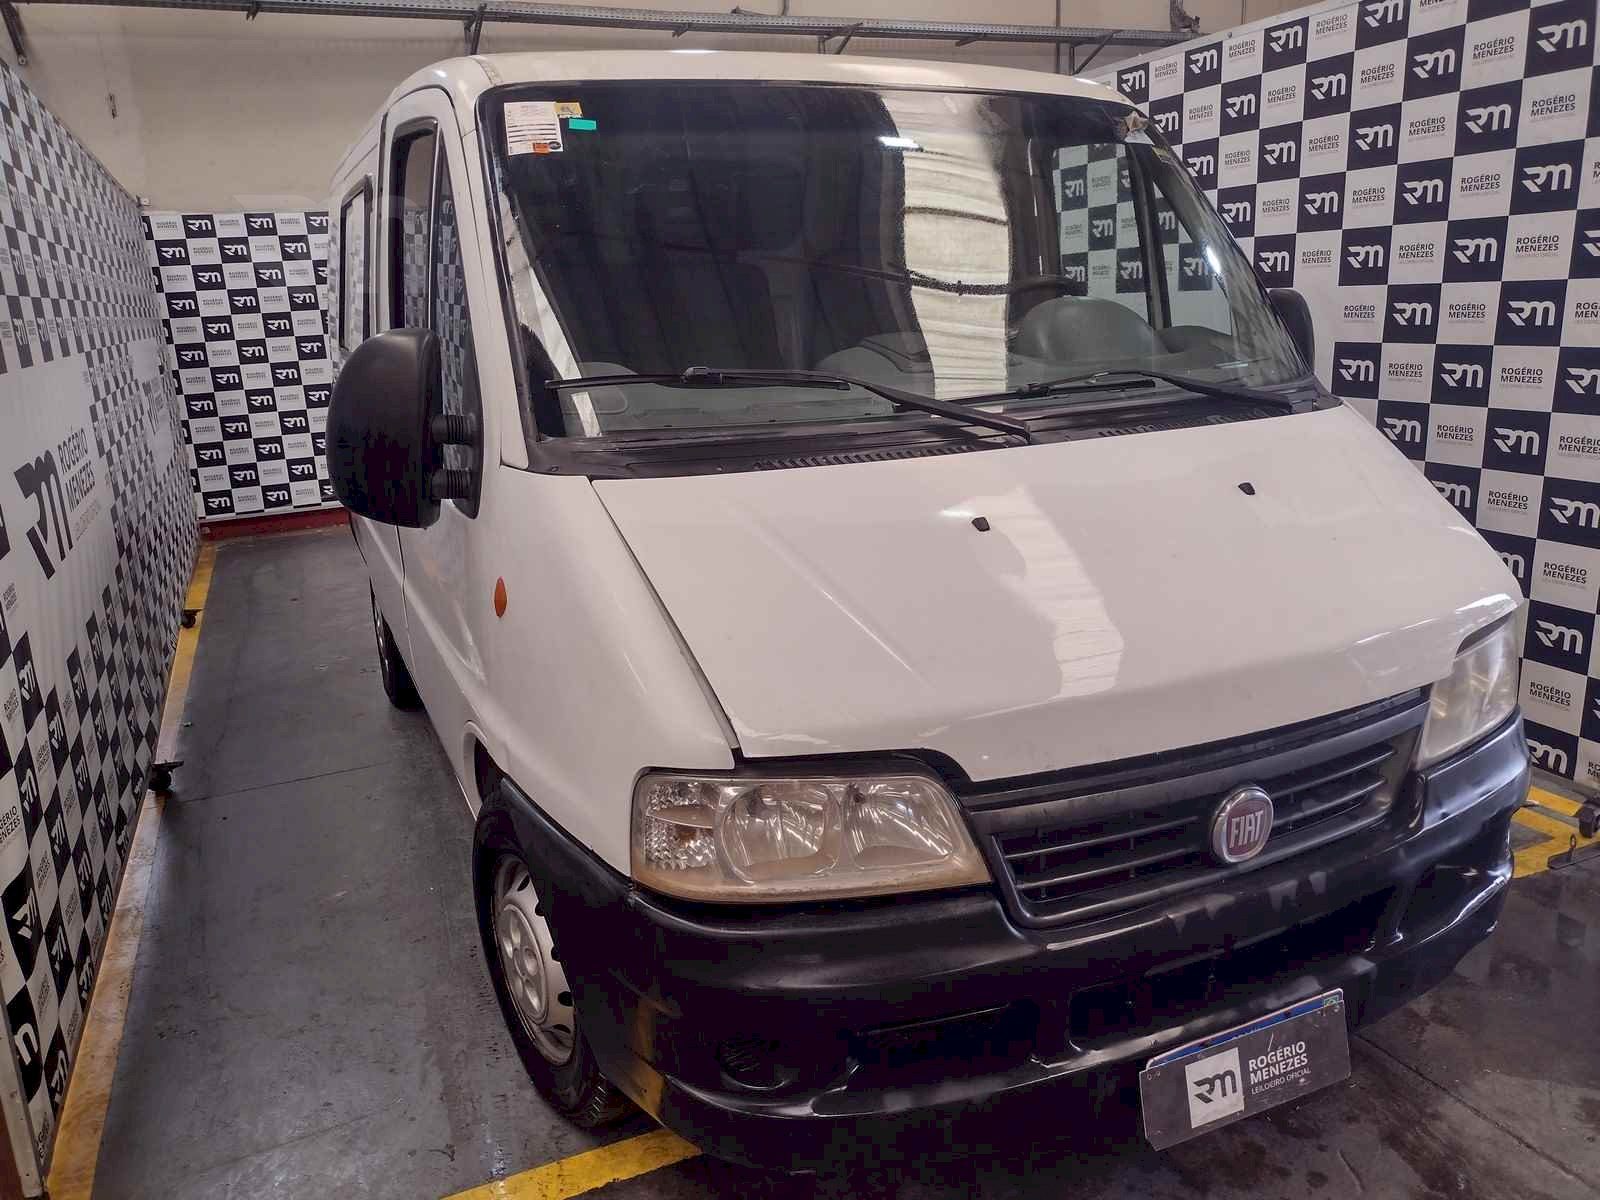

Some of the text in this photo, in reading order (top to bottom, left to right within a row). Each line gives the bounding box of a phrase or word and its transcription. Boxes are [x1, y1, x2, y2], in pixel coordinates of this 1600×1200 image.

[1472, 45, 1514, 60] MENEZES
[1531, 103, 1576, 117] MENEZES
[1409, 124, 1445, 137] MENEZES
[1460, 182, 1500, 192] MENEZES
[1352, 195, 1385, 203] MENEZES
[1399, 251, 1434, 259] MENEZES
[1515, 244, 1559, 253] MENEZES
[1448, 310, 1485, 319] MENEZES
[1388, 369, 1422, 378] MENEZES
[1501, 375, 1542, 384] MENEZES
[1436, 431, 1473, 441] MENEZES
[66, 460, 95, 512] MENEZES
[1488, 498, 1528, 510] MENEZES
[1543, 569, 1586, 584] MENEZES
[1529, 689, 1570, 706] MENEZES
[1229, 810, 1264, 848] FIAT
[1249, 1041, 1306, 1072] ROGÉRIO
[1250, 1052, 1307, 1085] MENEZES
[1252, 1068, 1311, 1095] LEILOEIRO OFICIAL
